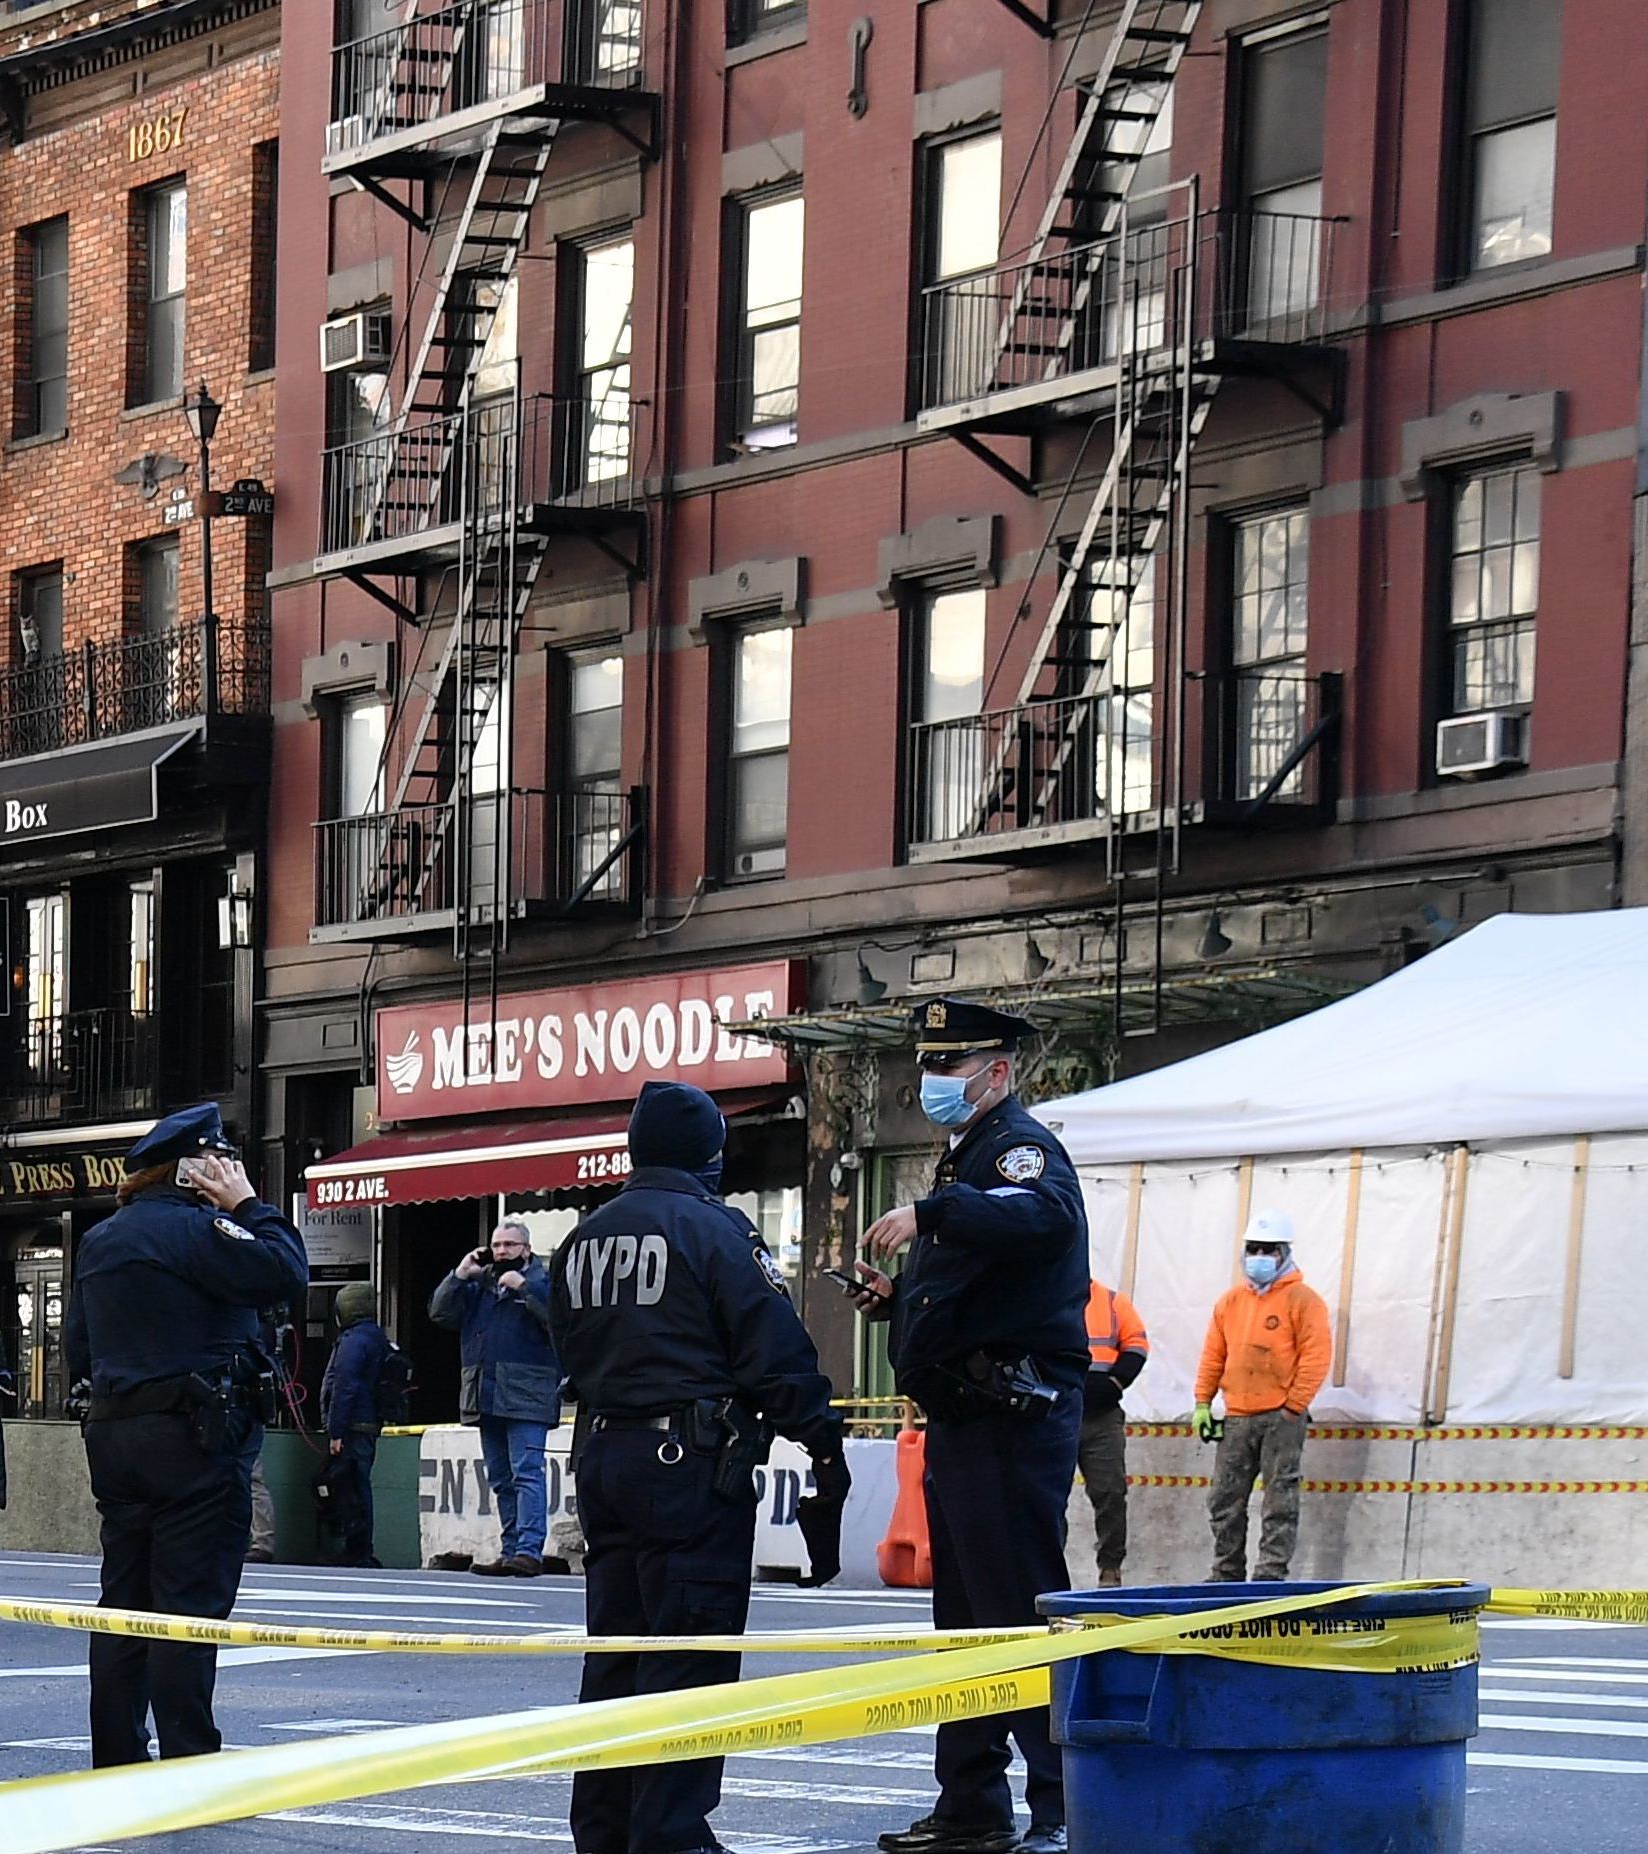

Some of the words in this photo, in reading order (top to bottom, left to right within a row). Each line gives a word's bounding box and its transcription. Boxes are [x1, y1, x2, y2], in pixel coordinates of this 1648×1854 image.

[128, 108, 189, 162] 1867
[5, 800, 48, 833] BOX
[431, 1014, 564, 1091] MEE'S
[573, 991, 775, 1077] NOODLE
[9, 1161, 75, 1194] PRESS
[82, 1155, 128, 1187] BOX
[317, 1181, 343, 1204] 930
[345, 1179, 355, 1201] 2
[356, 1177, 389, 1200] AVE.
[331, 1210, 362, 1226] Rent
[565, 1234, 668, 1310] NYPD
